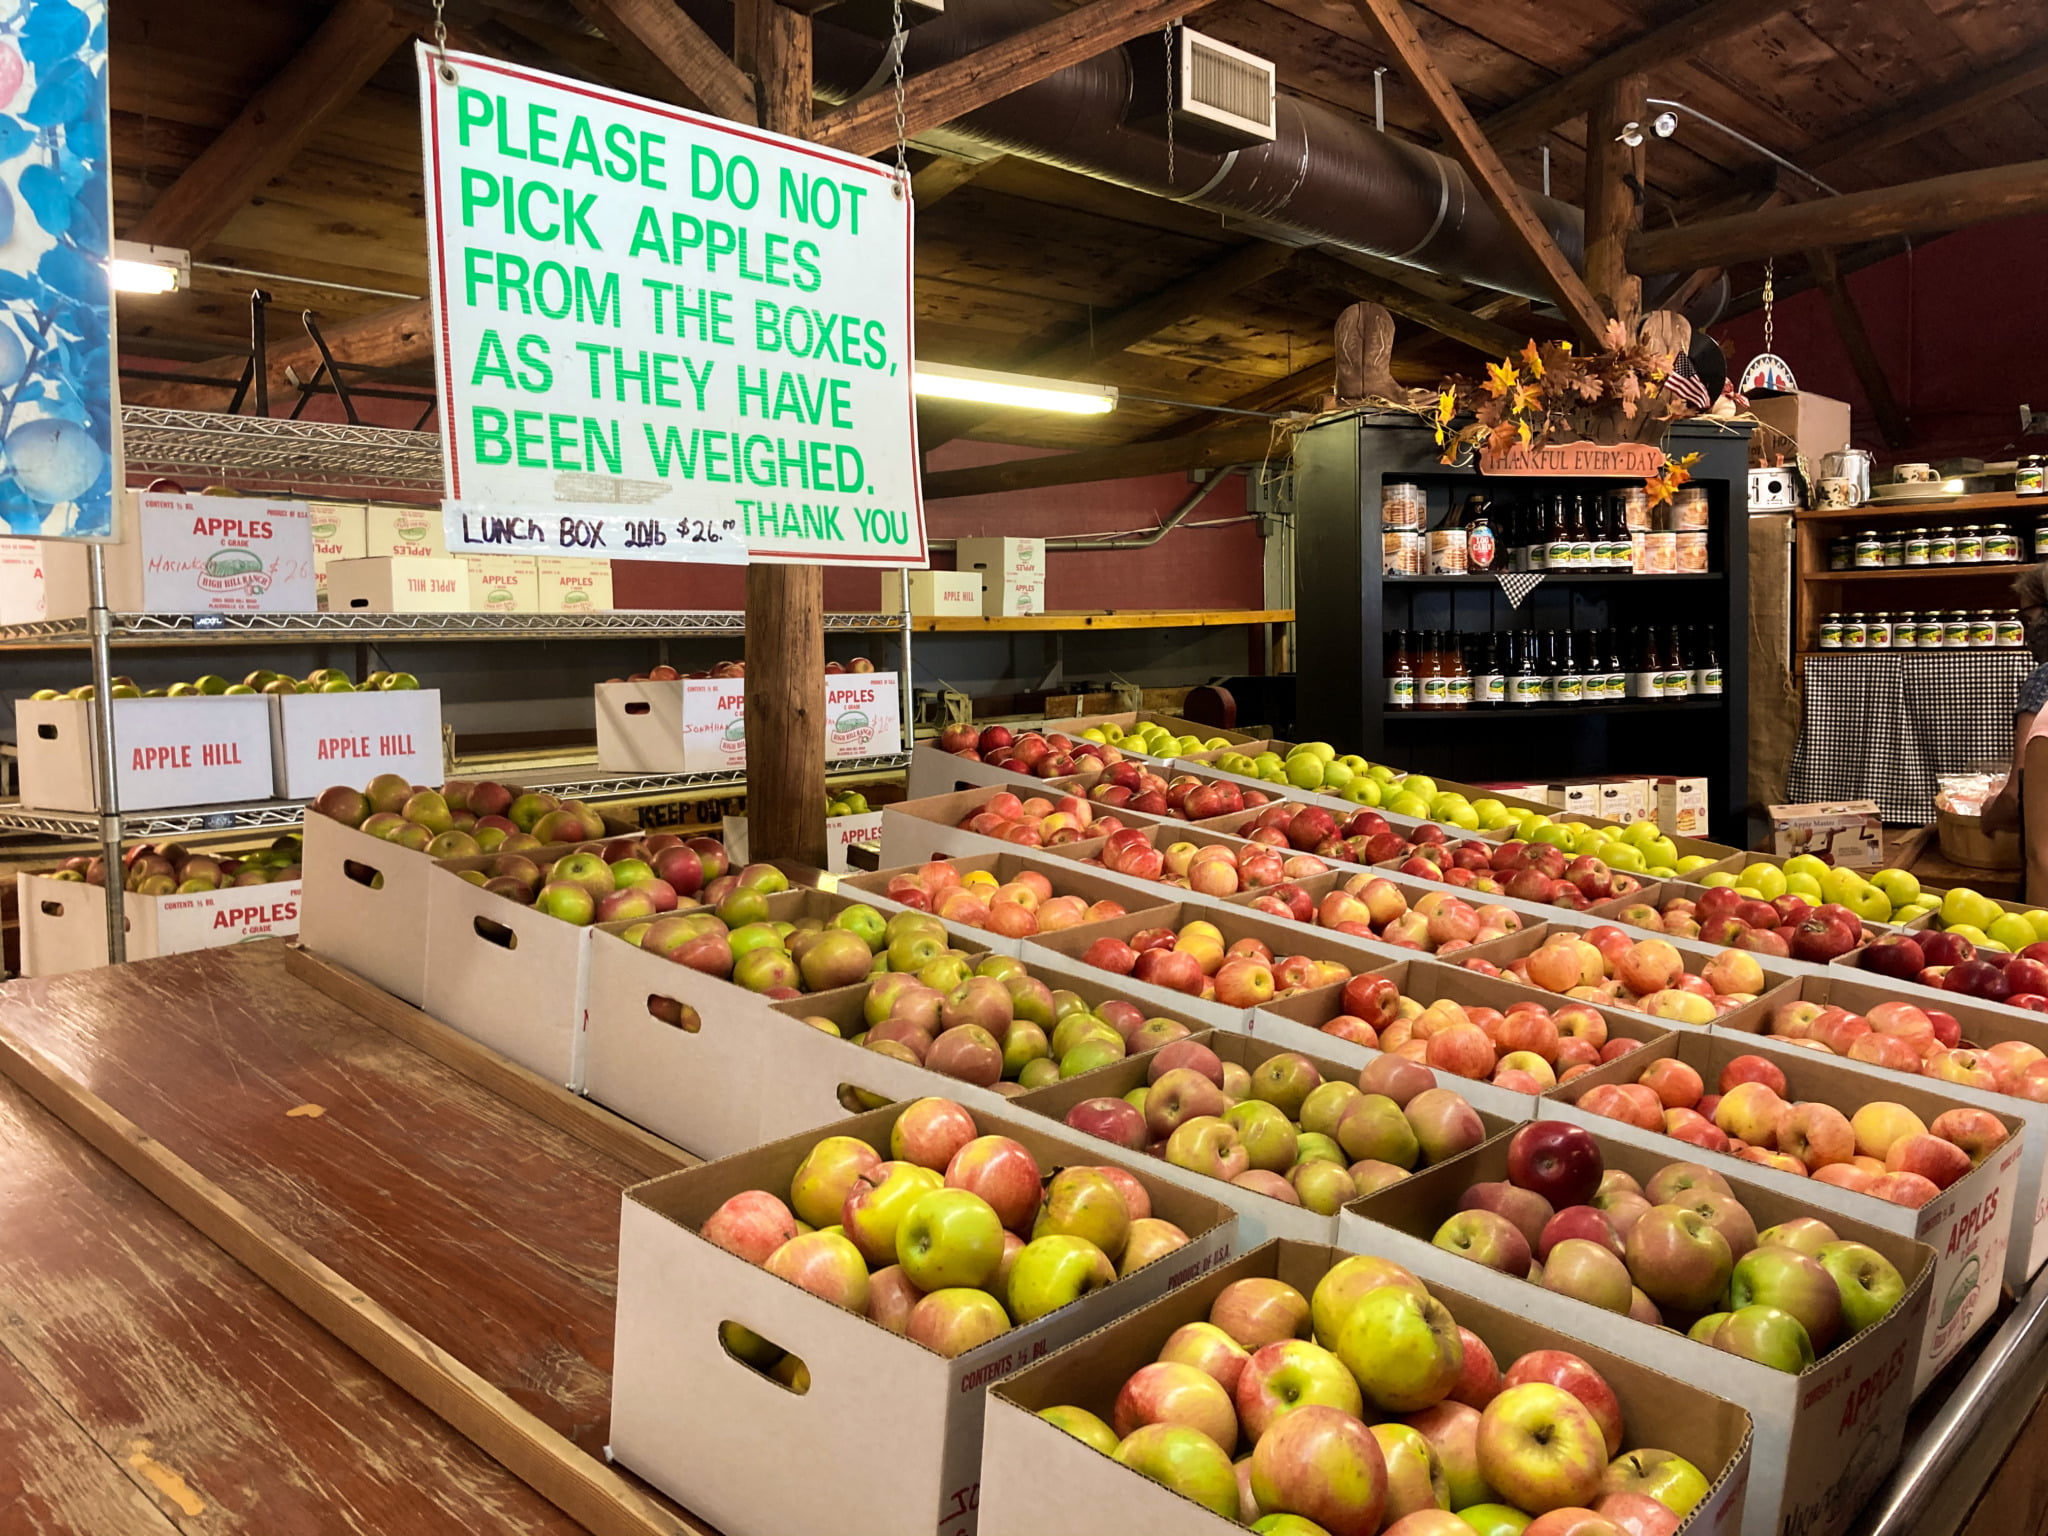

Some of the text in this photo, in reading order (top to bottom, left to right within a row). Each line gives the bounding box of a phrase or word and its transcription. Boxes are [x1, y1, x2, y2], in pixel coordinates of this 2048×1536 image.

[457, 86, 868, 235] PLEASE DO NOT
[460, 166, 821, 292] PICK APPLES
[464, 247, 898, 377] FROM THE BOXES,
[471, 329, 853, 429] AS THEY HAVE
[472, 406, 874, 495] BEEN WEIGHED.
[1489, 449, 1657, 471] THANKFUL EVERY DAY
[192, 517, 273, 539] APPLES
[560, 517, 606, 548] BOX
[735, 500, 909, 544] THANK YOU
[228, 539, 249, 548] GRADE
[313, 543, 343, 554] APPL
[393, 545, 432, 556] APPLES
[1015, 564, 1035, 572] APPLES
[202, 573, 268, 589] HIGH HILL RANCH
[408, 579, 456, 592] APPLE HILL
[482, 575, 518, 585] APPLES
[560, 576, 594, 586] APPLES
[1015, 584, 1035, 592] APPLES
[943, 591, 974, 602] APPLE HILL
[717, 695, 744, 710] APP
[828, 689, 875, 704] APPLES
[132, 742, 242, 770] APPLE HILL
[317, 734, 417, 760] APPLE HILL
[637, 801, 691, 828] KEEP
[696, 797, 732, 823] OUT
[164, 900, 194, 910] CONTENTS
[213, 902, 297, 929] APPLES
[241, 924, 272, 935] C GRADE
[1944, 1186, 1999, 1260] APPLES
[961, 1355, 1012, 1393] CONTENTS
[1837, 1337, 1907, 1437] APPLES
